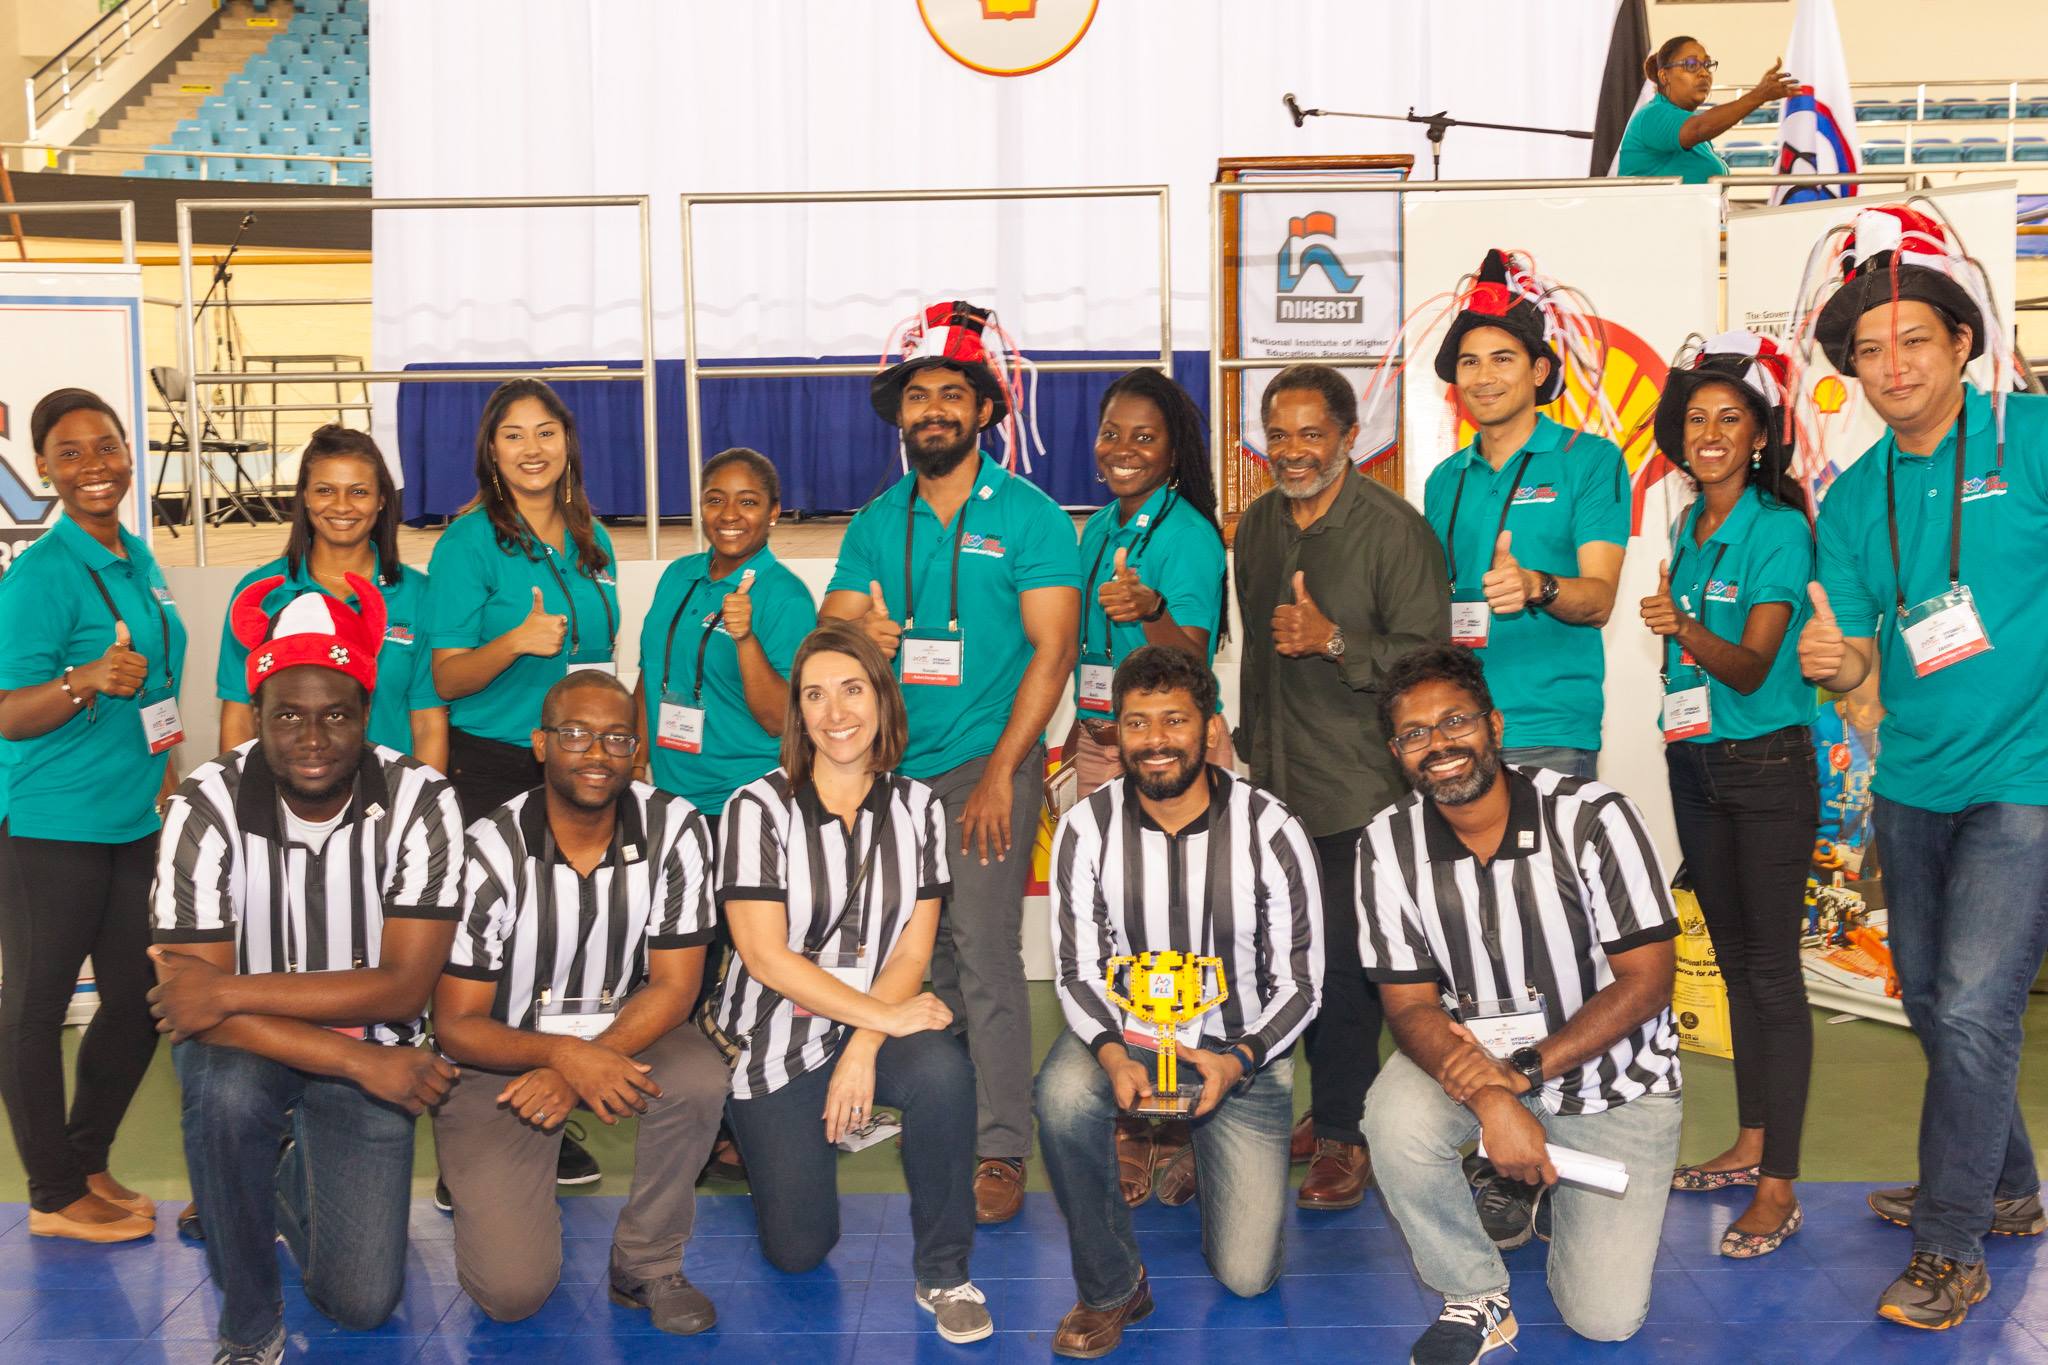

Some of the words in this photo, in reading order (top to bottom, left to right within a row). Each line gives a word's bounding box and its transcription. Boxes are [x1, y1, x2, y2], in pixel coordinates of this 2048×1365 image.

[1280, 300, 1358, 320] NIHERST
[1252, 337, 1292, 346] National
[1296, 339, 1339, 347] Institute
[1343, 339, 1352, 347] of
[1356, 339, 1389, 348] Higher
